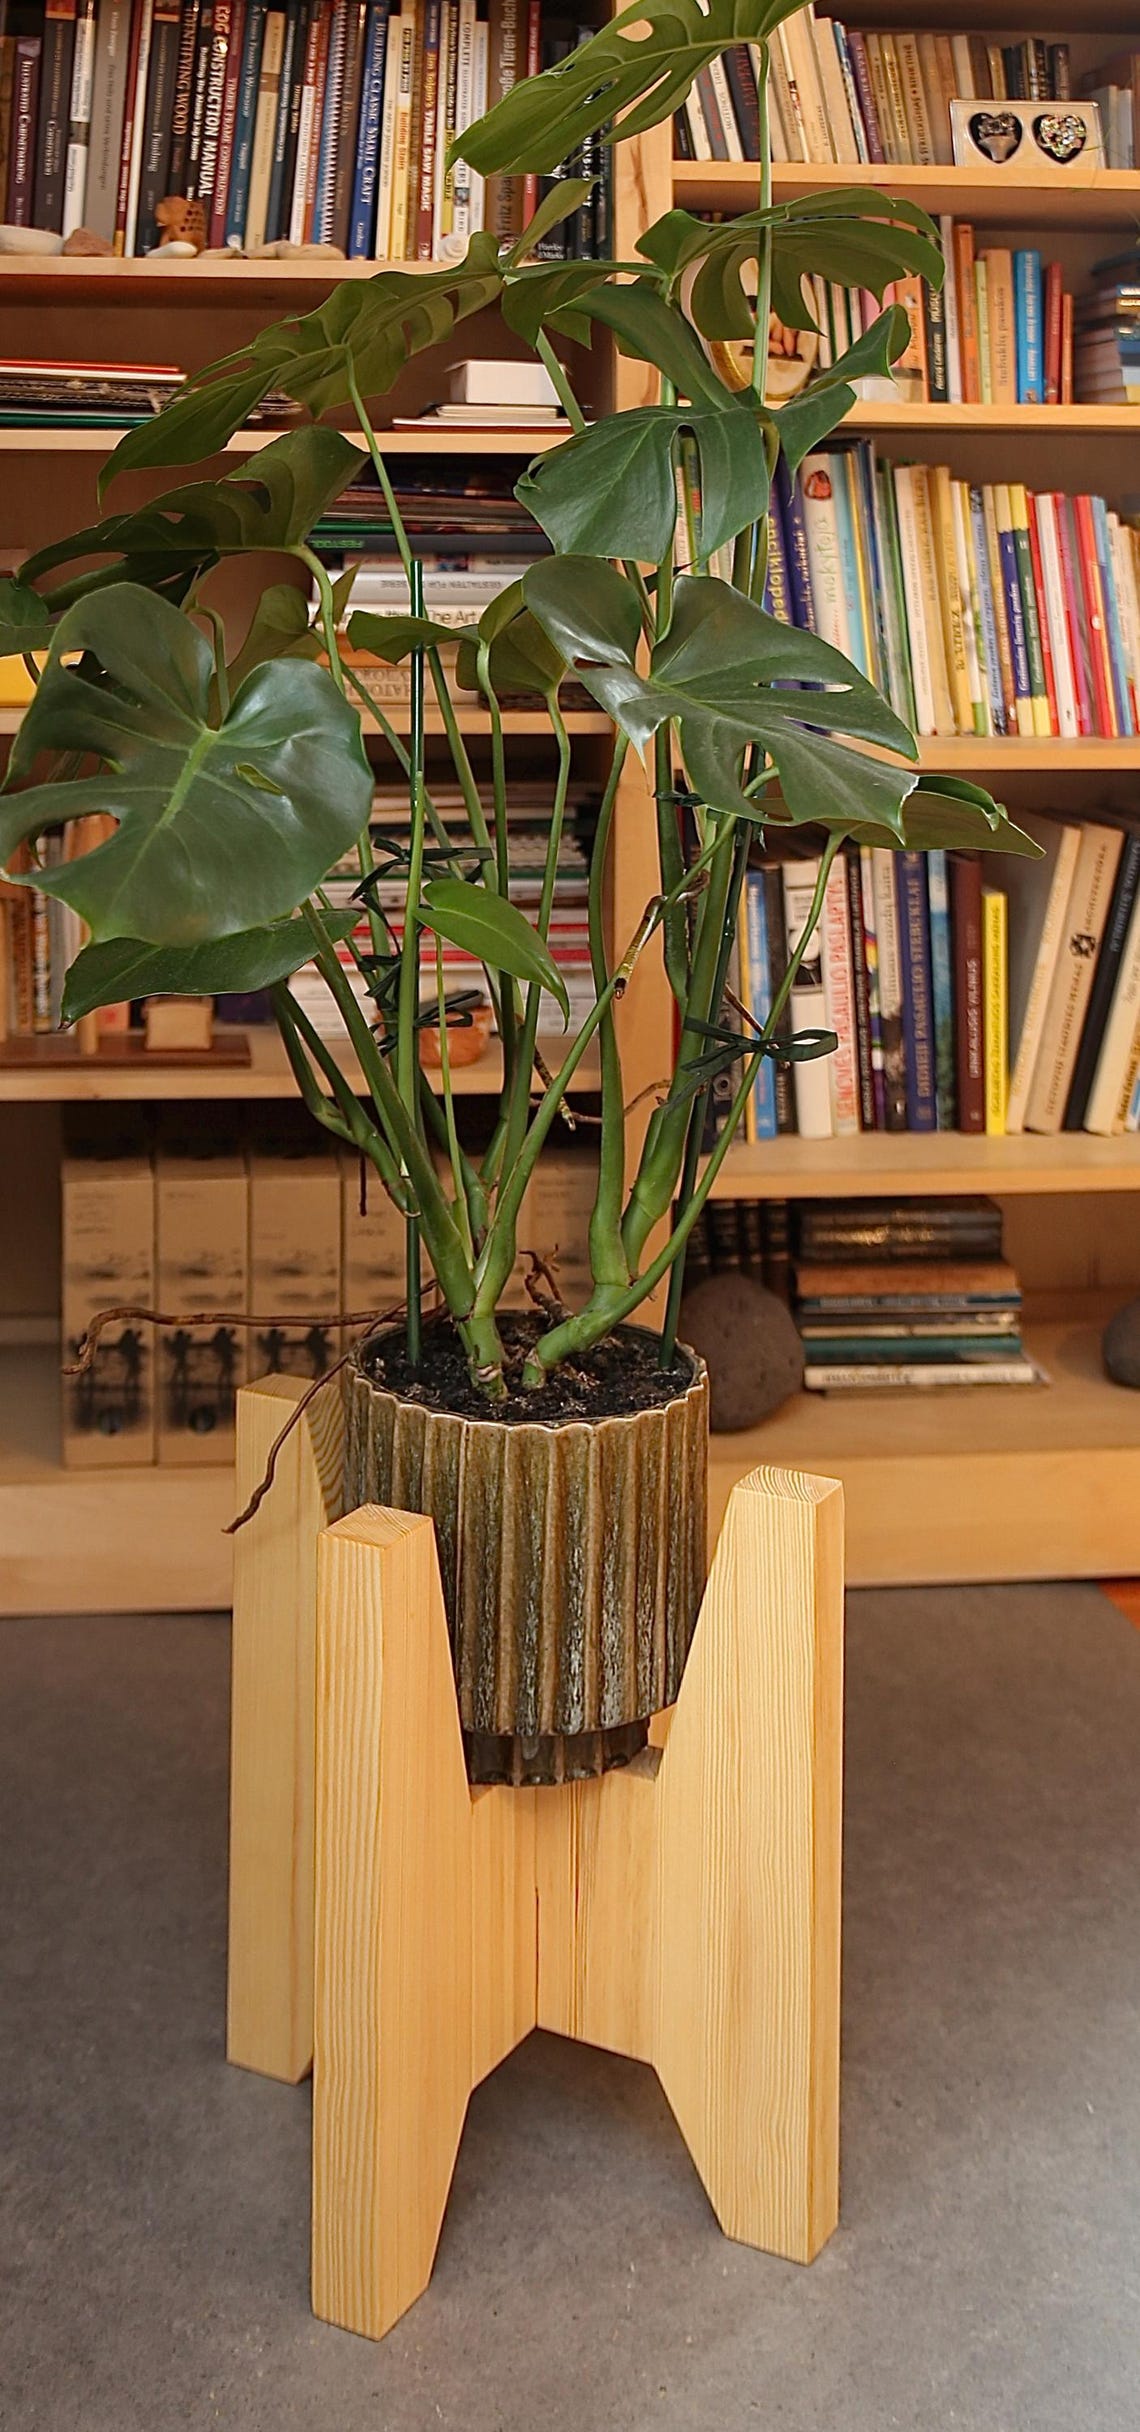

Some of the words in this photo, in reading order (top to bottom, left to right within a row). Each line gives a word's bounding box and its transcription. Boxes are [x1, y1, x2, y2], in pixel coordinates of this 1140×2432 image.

[213, 6, 231, 34] LOG
[498, 0, 517, 69] Türen-Buch
[370, 22, 387, 78] BUILDING
[426, 52, 438, 70] Jim
[461, 22, 472, 66] COMPLETE
[197, 46, 209, 79] Building
[204, 36, 227, 136] CONSTRUCTION
[424, 72, 437, 108] Tolpin's
[498, 69, 517, 98] roße
[172, 93, 191, 135] WOOD
[193, 95, 205, 120] Alaska
[366, 79, 383, 125] CLASSIC
[221, 111, 233, 144] FRAME
[398, 111, 410, 145] Building
[421, 110, 435, 145] TABLE
[189, 137, 200, 161] Home
[363, 127, 380, 165] SMALL
[397, 147, 408, 170] Stairs
[420, 148, 433, 174] SAW
[198, 140, 218, 198] MANUAL
[215, 146, 231, 215] CONSTRUCTION
[359, 166, 377, 206] CRAFT
[419, 176, 432, 212] MAGIC
[309, 538, 364, 550] FESTOOL
[767, 518, 790, 624] encikloped
[455, 609, 477, 623] Art
